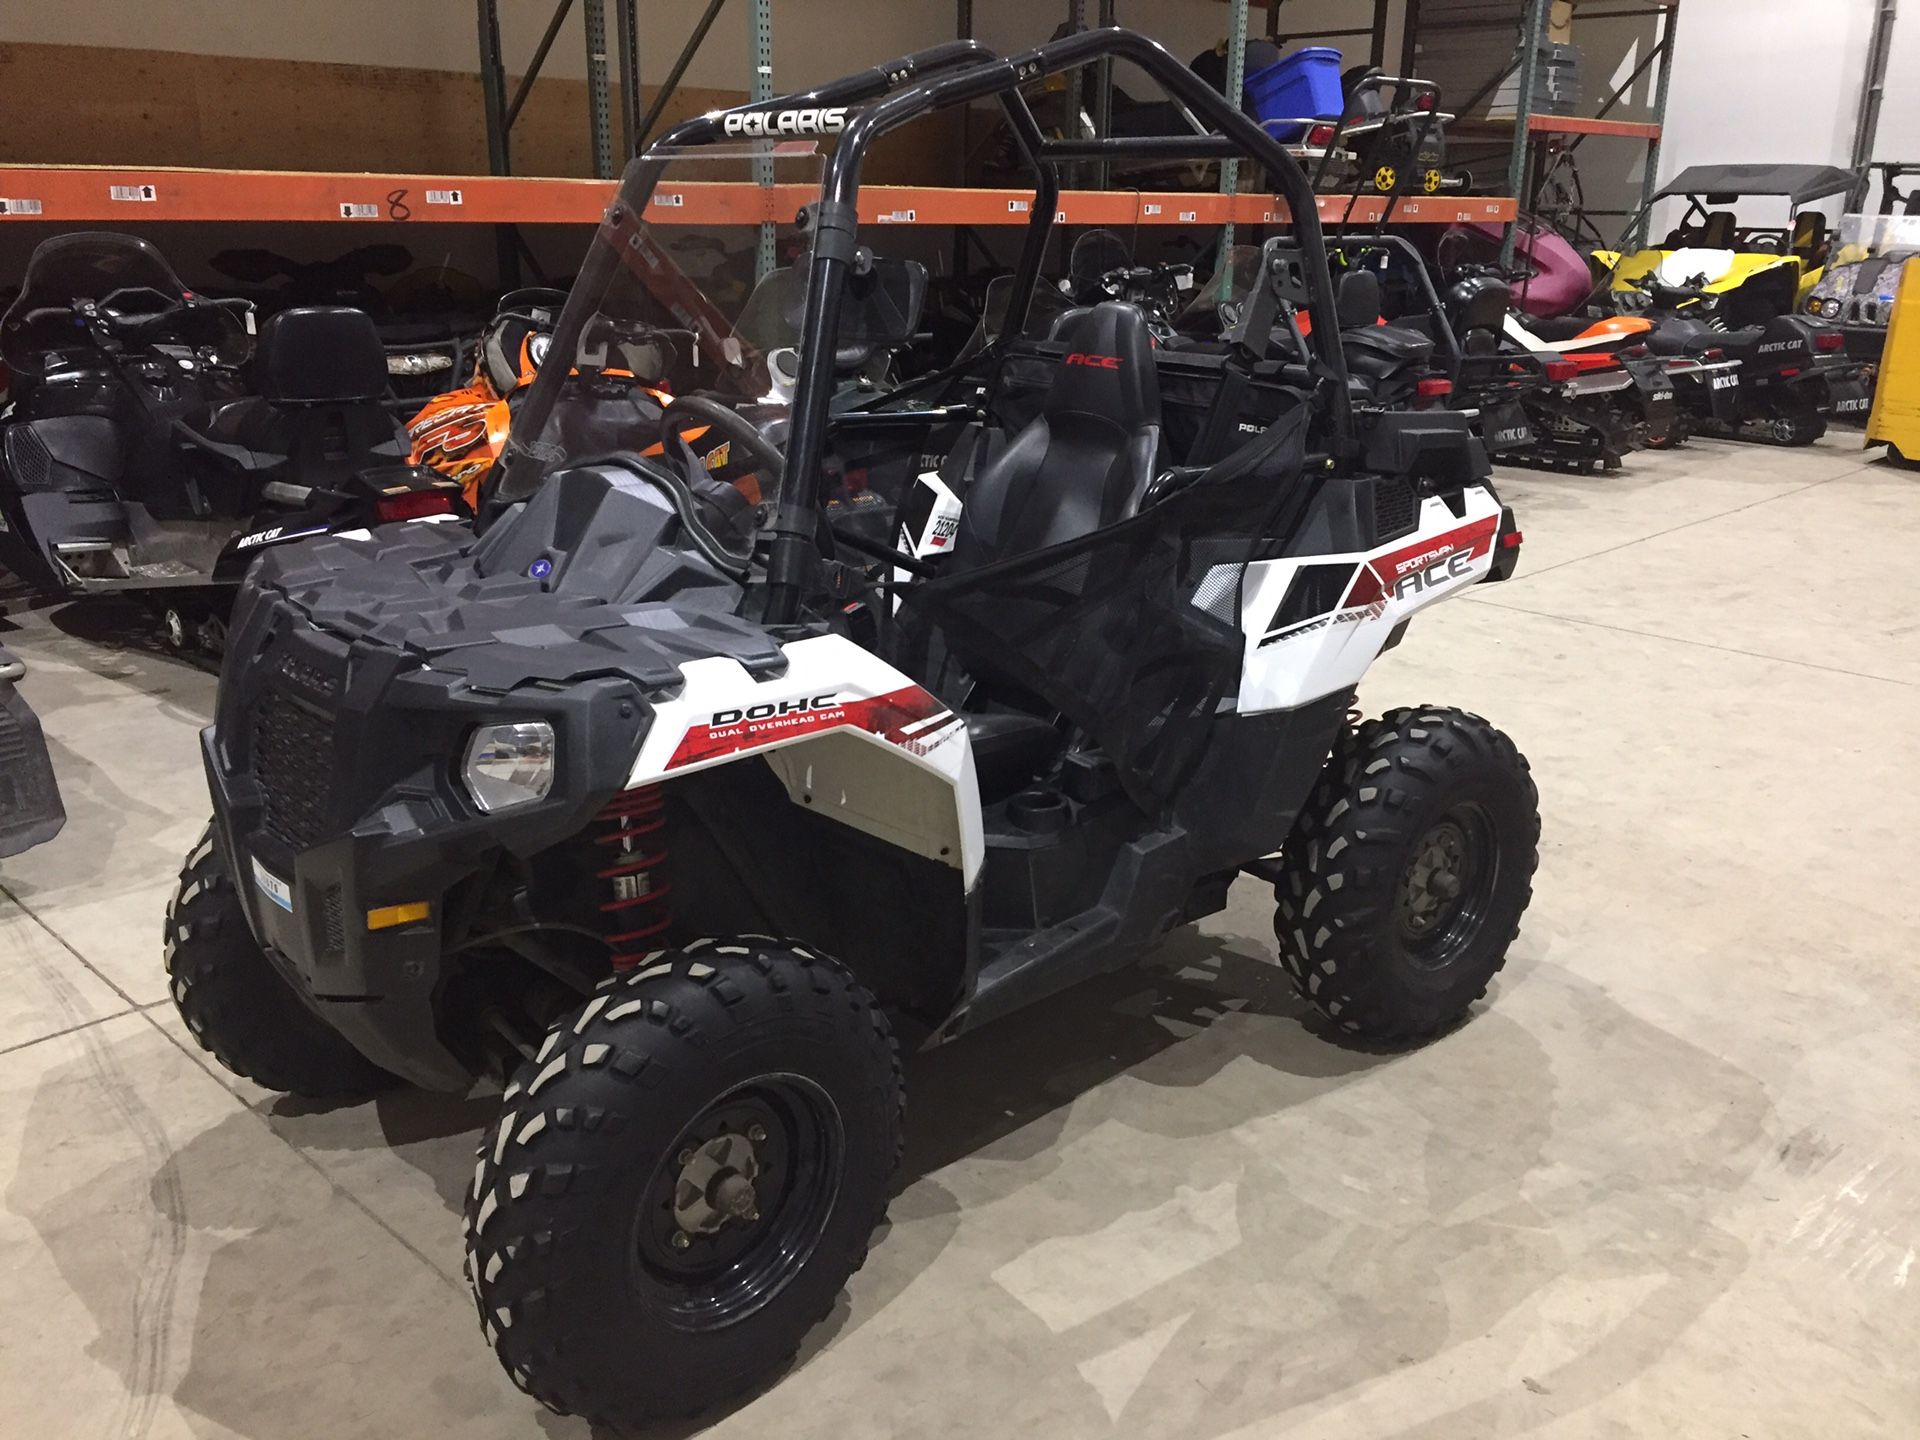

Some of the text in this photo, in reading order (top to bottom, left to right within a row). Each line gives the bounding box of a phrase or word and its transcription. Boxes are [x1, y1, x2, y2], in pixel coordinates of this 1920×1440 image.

[724, 107, 848, 137] POLARIS
[386, 189, 411, 221] 8
[1758, 339, 1803, 353] ARCTIC CAT
[1066, 353, 1123, 369] ACE
[1836, 400, 1858, 412] ARCTIC
[237, 526, 283, 549] ARCTIC CAT
[1395, 543, 1455, 574] SPORTSMAN
[1395, 550, 1474, 601] ACE
[709, 710, 845, 739] DUAL OVERHEAD CAM
[711, 693, 838, 727] DOHC
